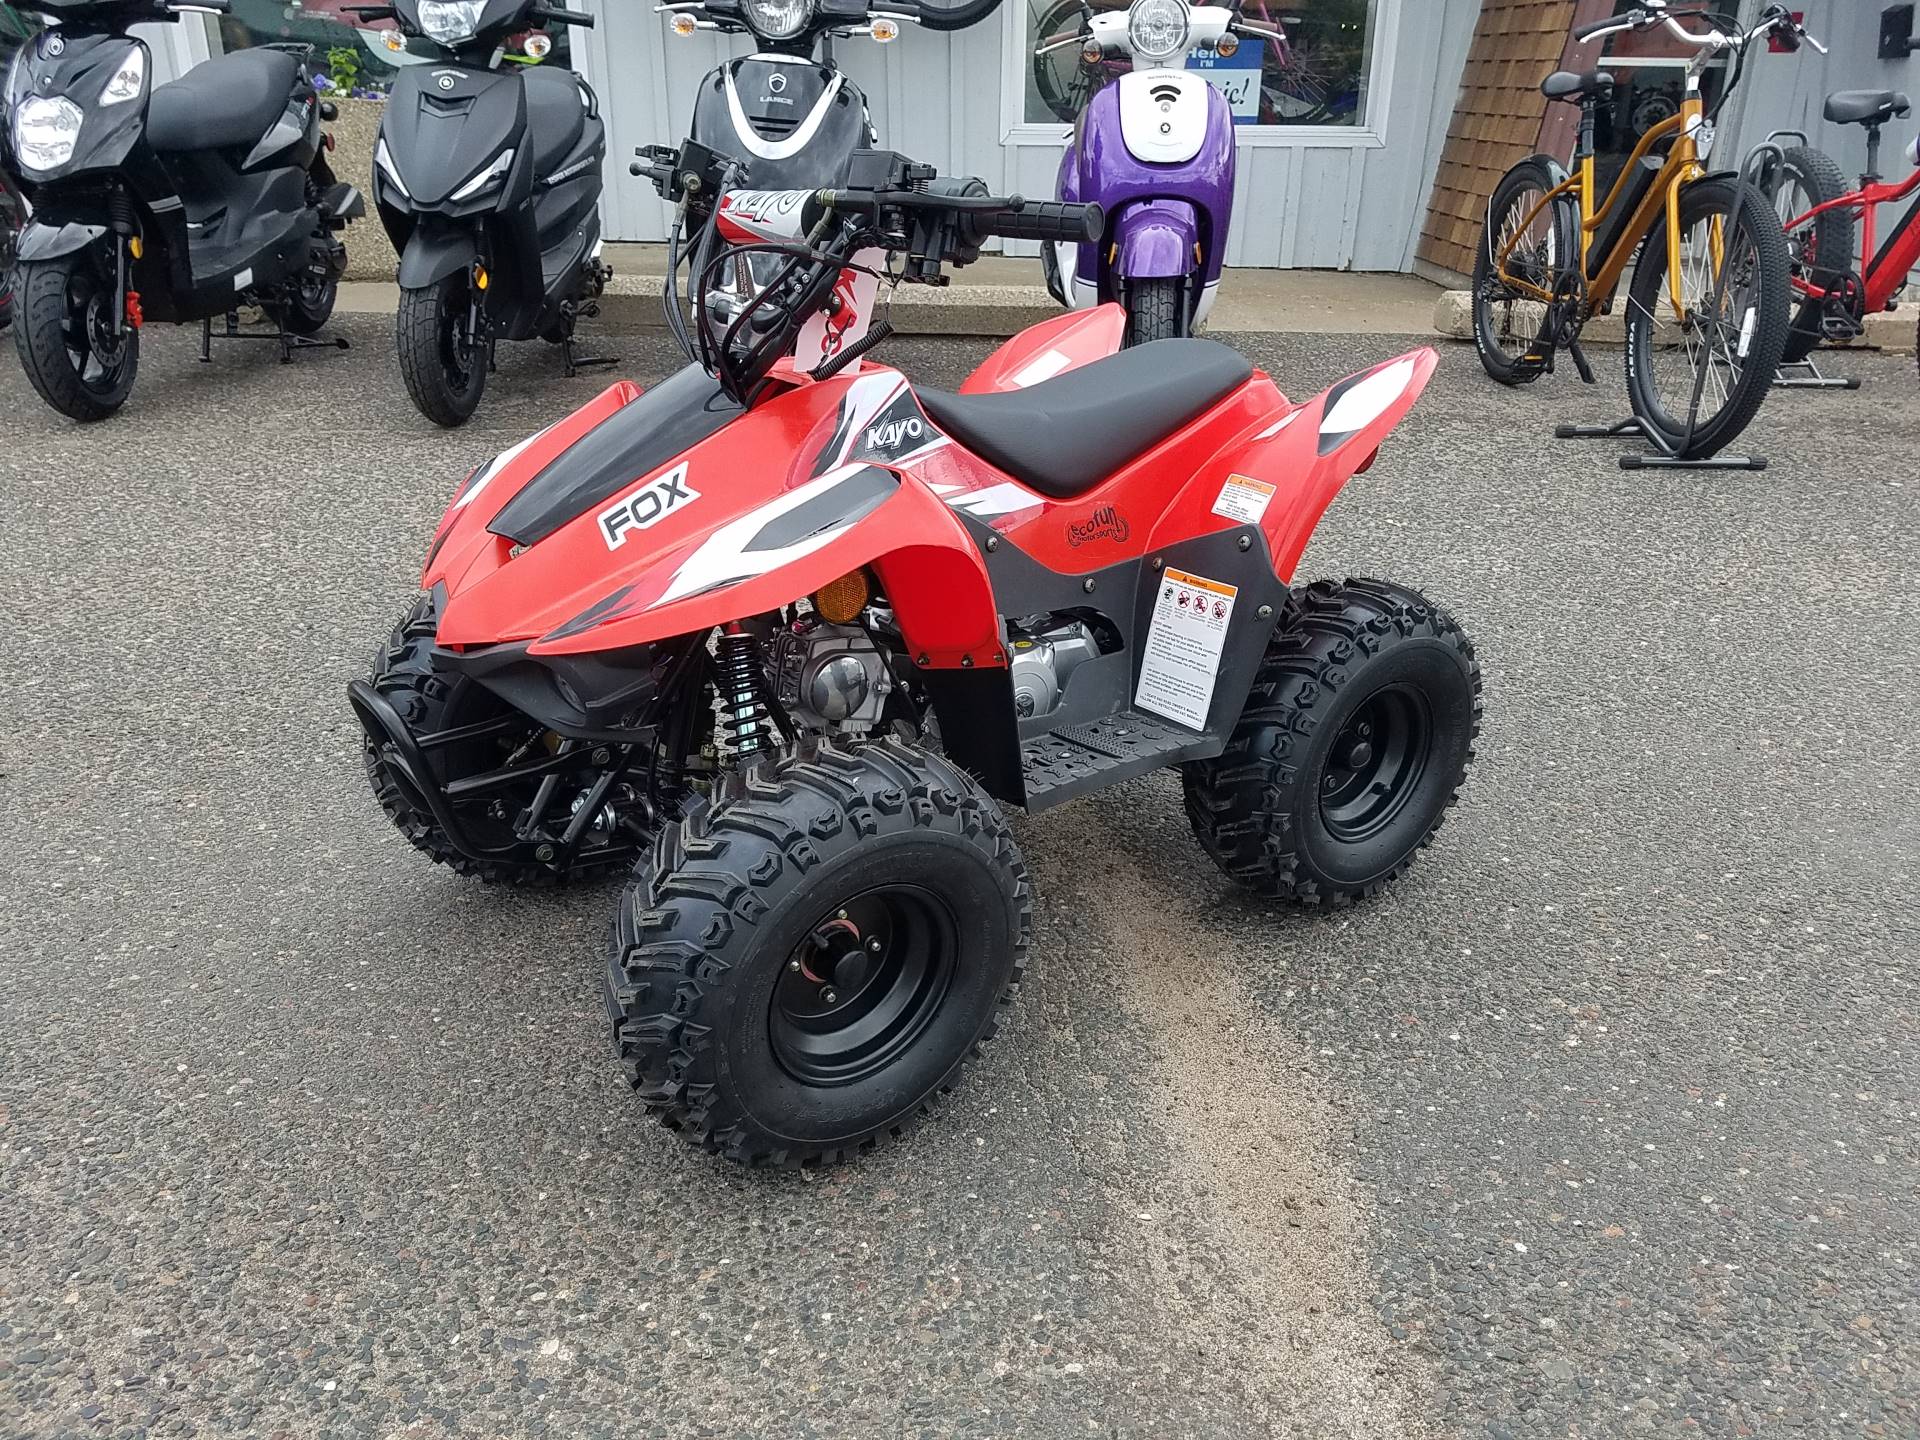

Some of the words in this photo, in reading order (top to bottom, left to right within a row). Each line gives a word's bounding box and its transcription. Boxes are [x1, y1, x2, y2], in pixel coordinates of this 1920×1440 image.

[760, 96, 794, 105] LANCE
[1628, 321, 1636, 377] KENDA
[865, 409, 924, 451] KAYO
[603, 472, 689, 543] FOX
[1071, 504, 1121, 536] ecofun
